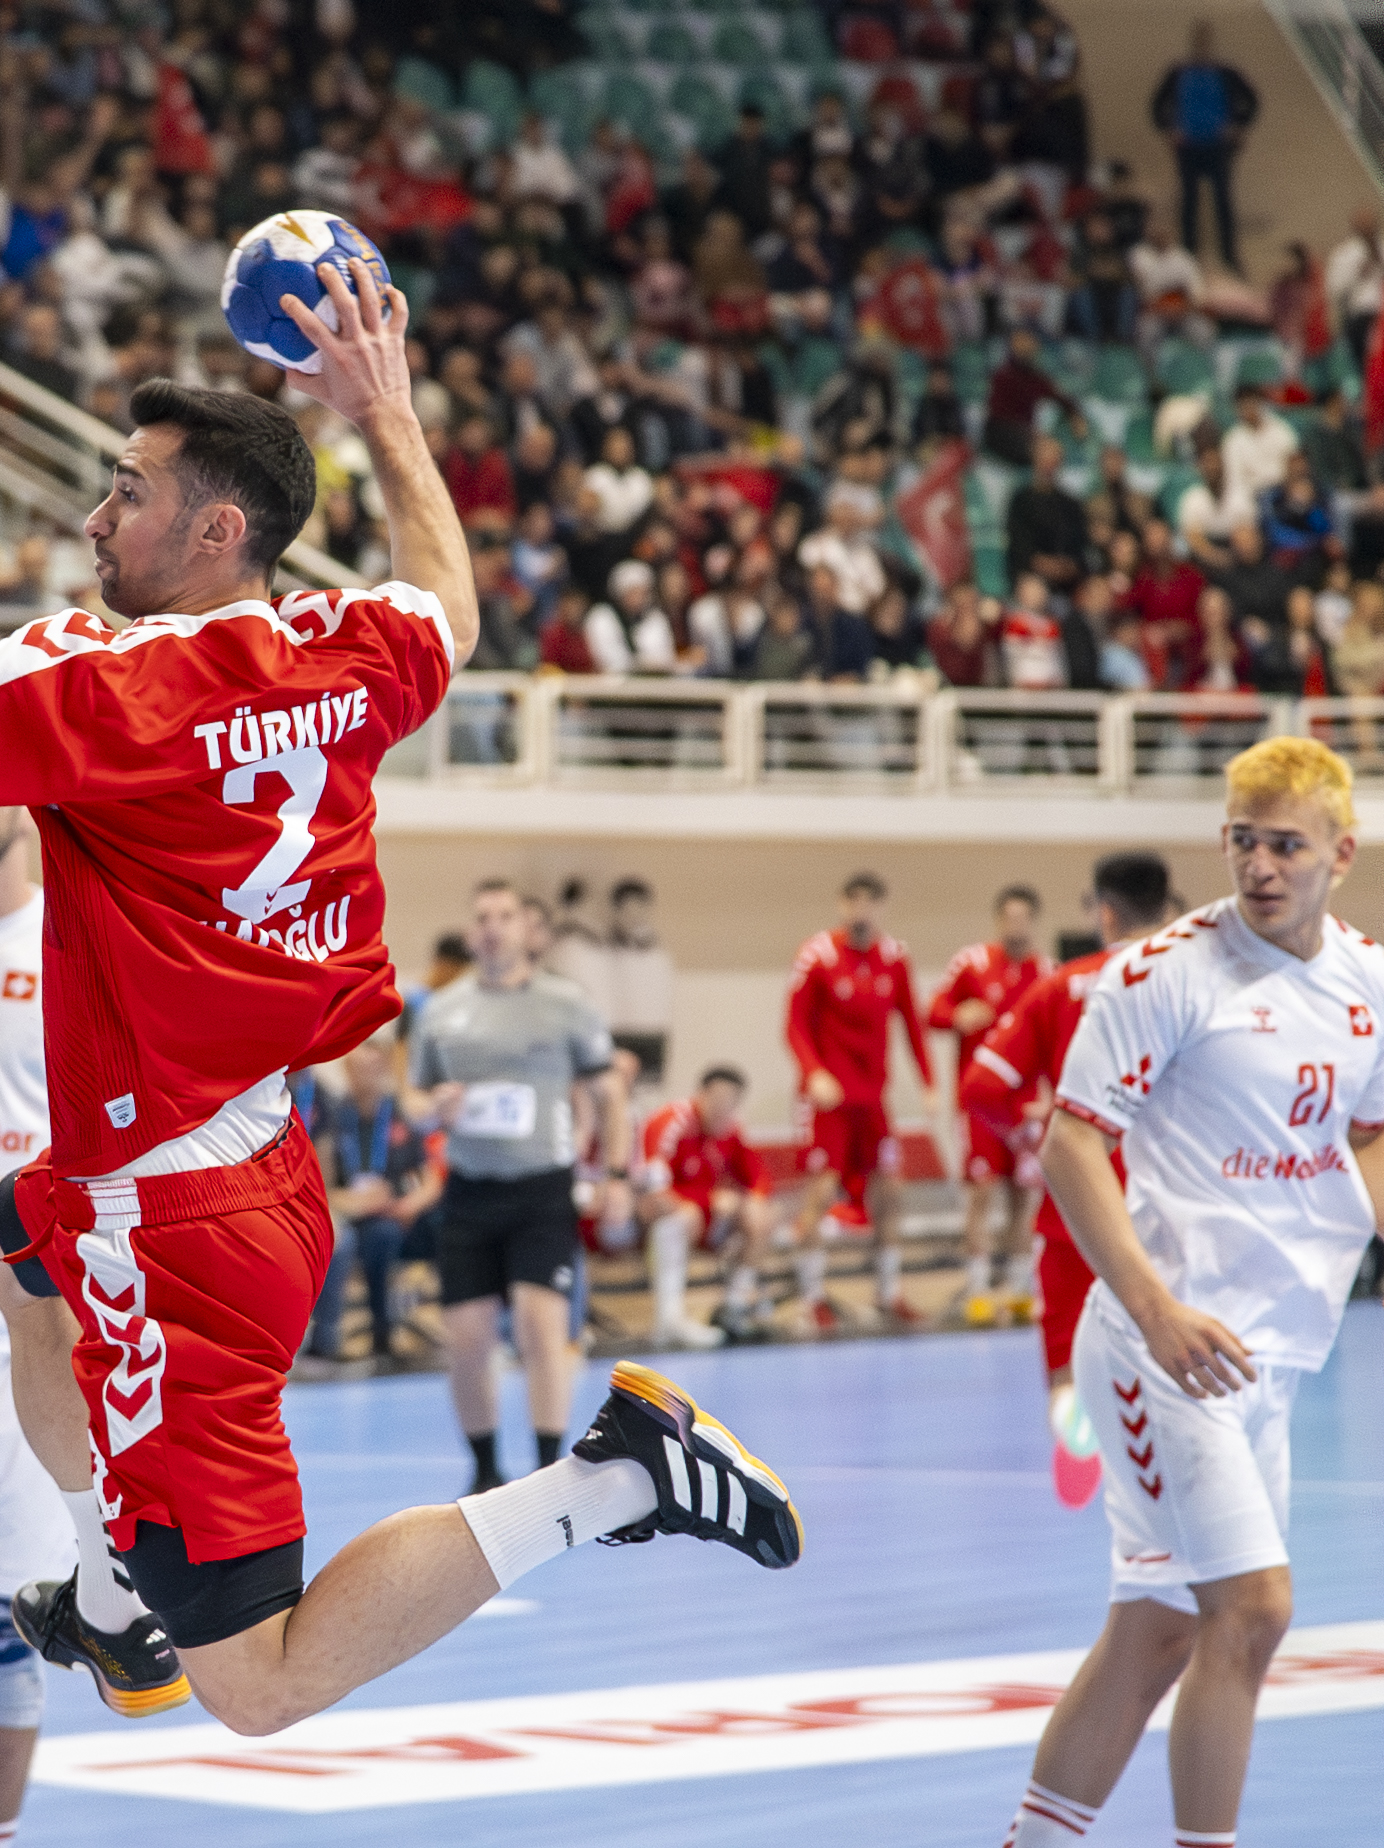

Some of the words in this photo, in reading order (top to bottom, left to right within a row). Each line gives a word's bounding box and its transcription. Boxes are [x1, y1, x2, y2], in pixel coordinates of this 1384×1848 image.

[194, 686, 369, 770] TÜRKİYE
[222, 746, 328, 924] 2
[1288, 1063, 1335, 1128] 21
[1222, 1147, 1270, 1181] die
